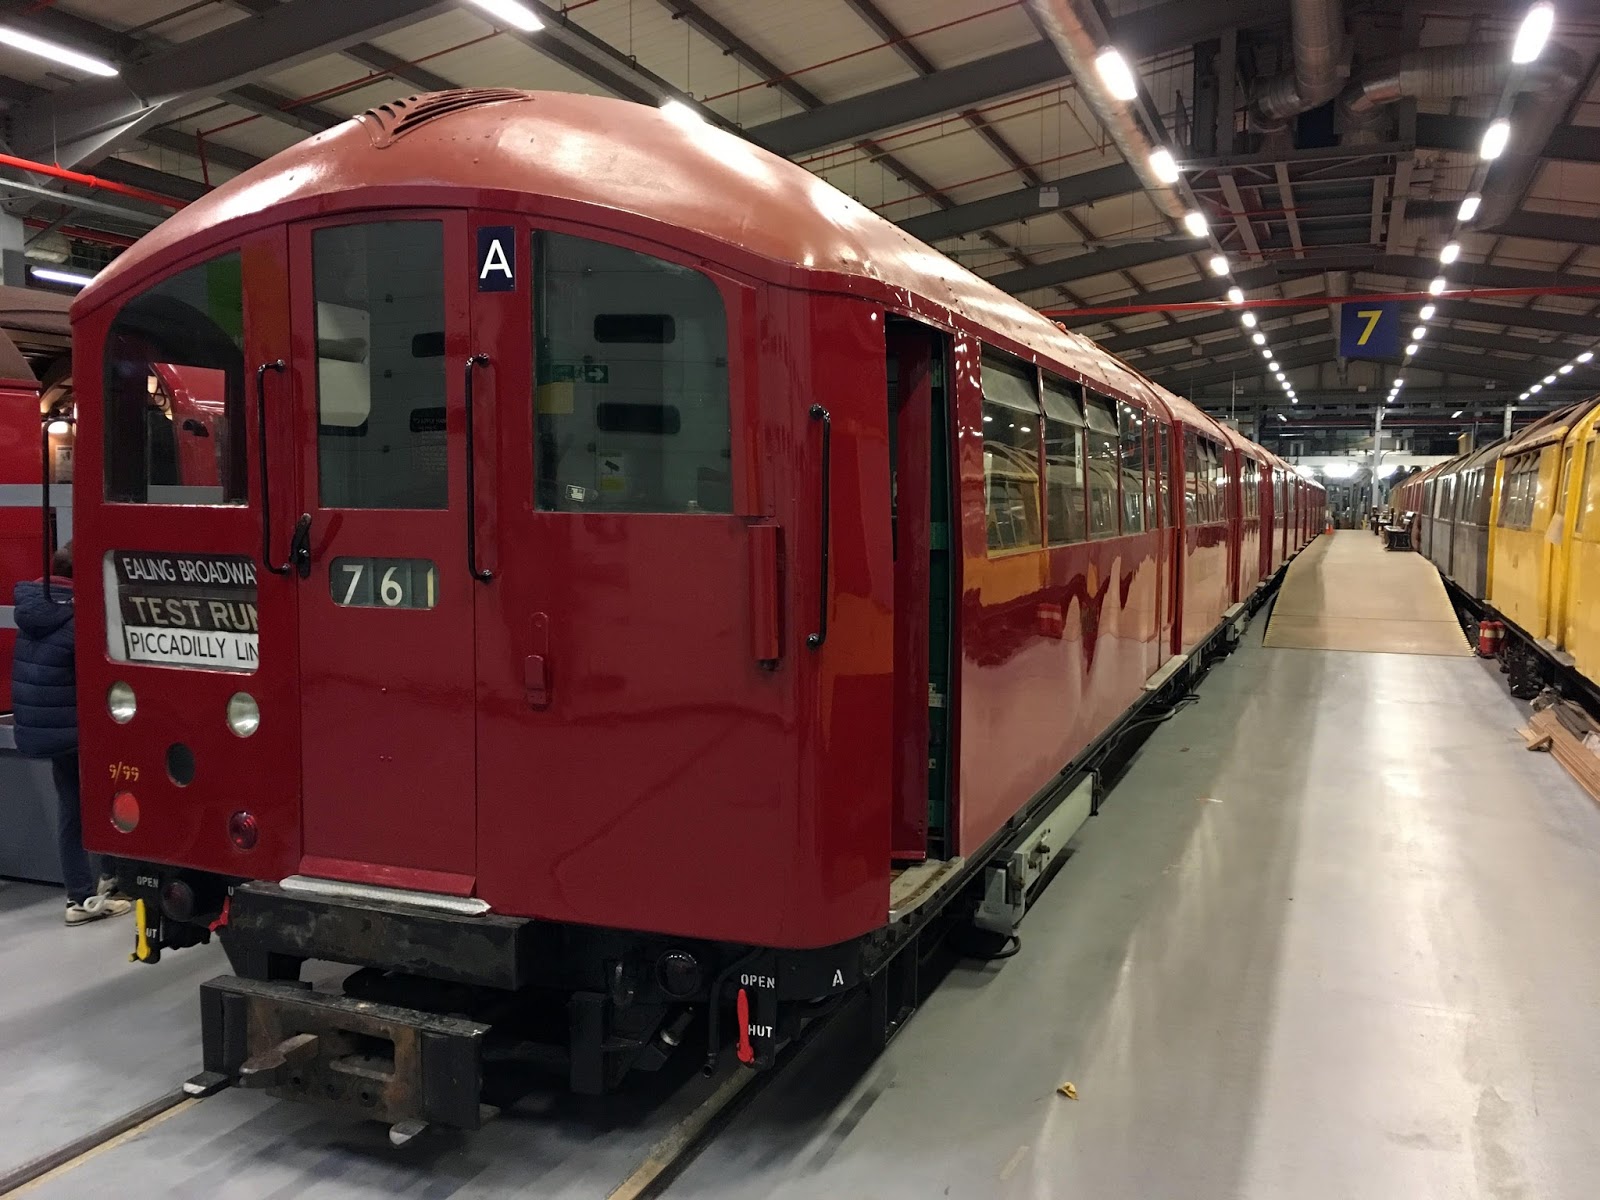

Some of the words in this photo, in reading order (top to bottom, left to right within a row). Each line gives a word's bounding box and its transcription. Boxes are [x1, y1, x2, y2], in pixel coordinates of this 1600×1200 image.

[480, 239, 513, 279] A
[1357, 310, 1383, 346] 7
[123, 558, 176, 581] EALING
[177, 560, 258, 585] BROADWA
[129, 597, 201, 627] TEST
[130, 632, 226, 659] PICCADILLY
[109, 761, 139, 784] 9/99
[136, 875, 159, 889] OPEN
[740, 973, 775, 989] OPEN
[832, 968, 844, 987] A
[747, 1024, 773, 1039] HUT
